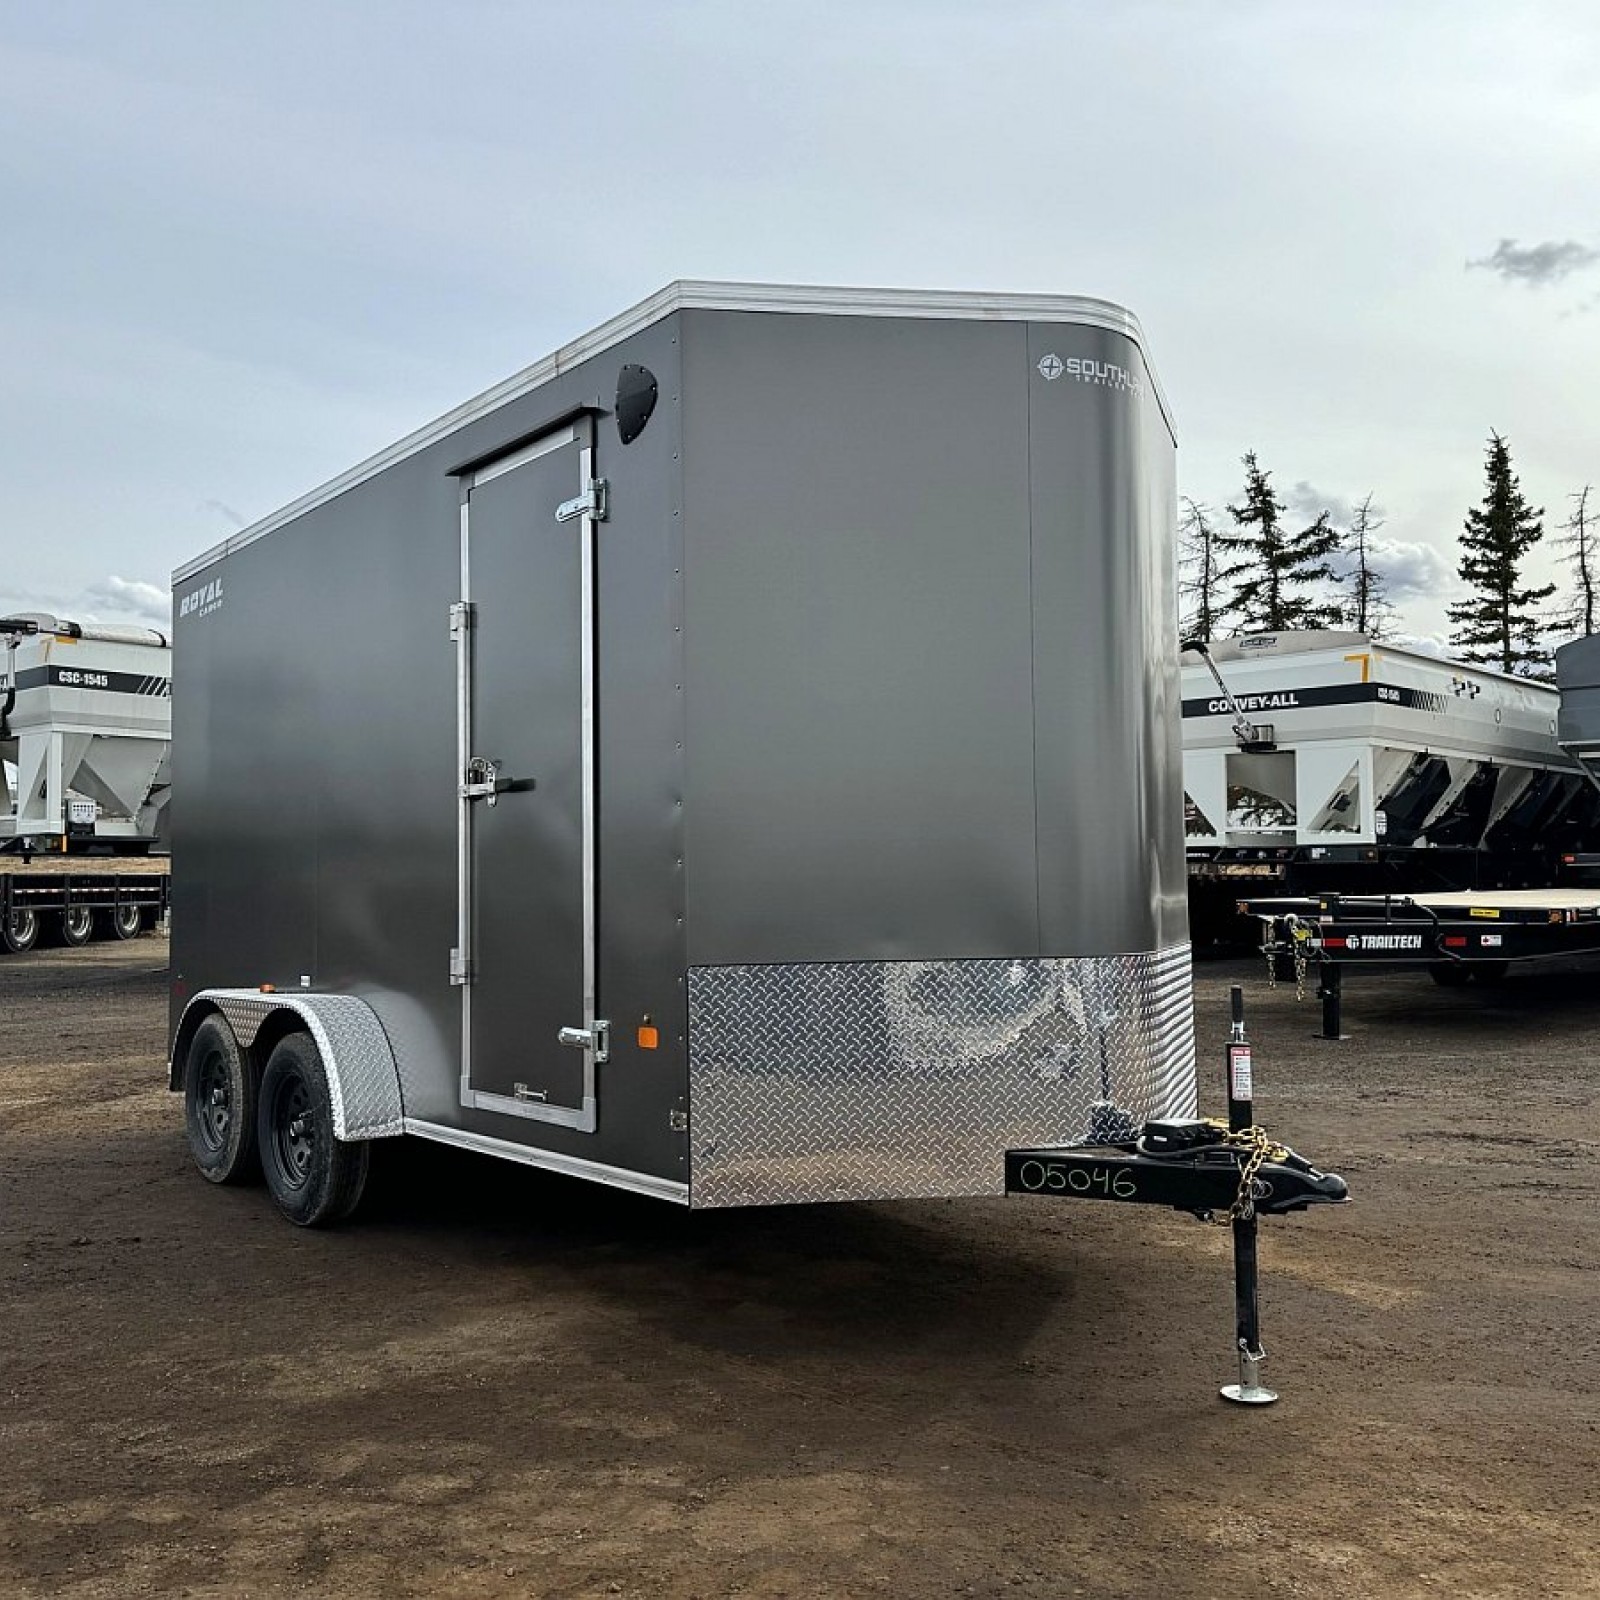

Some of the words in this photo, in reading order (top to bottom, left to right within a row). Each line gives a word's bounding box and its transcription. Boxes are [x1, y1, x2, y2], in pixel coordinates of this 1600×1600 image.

[179, 577, 224, 618] ROYAL
[1361, 934, 1422, 949] TRAILTECH
[1020, 1160, 1137, 1198] 05046
